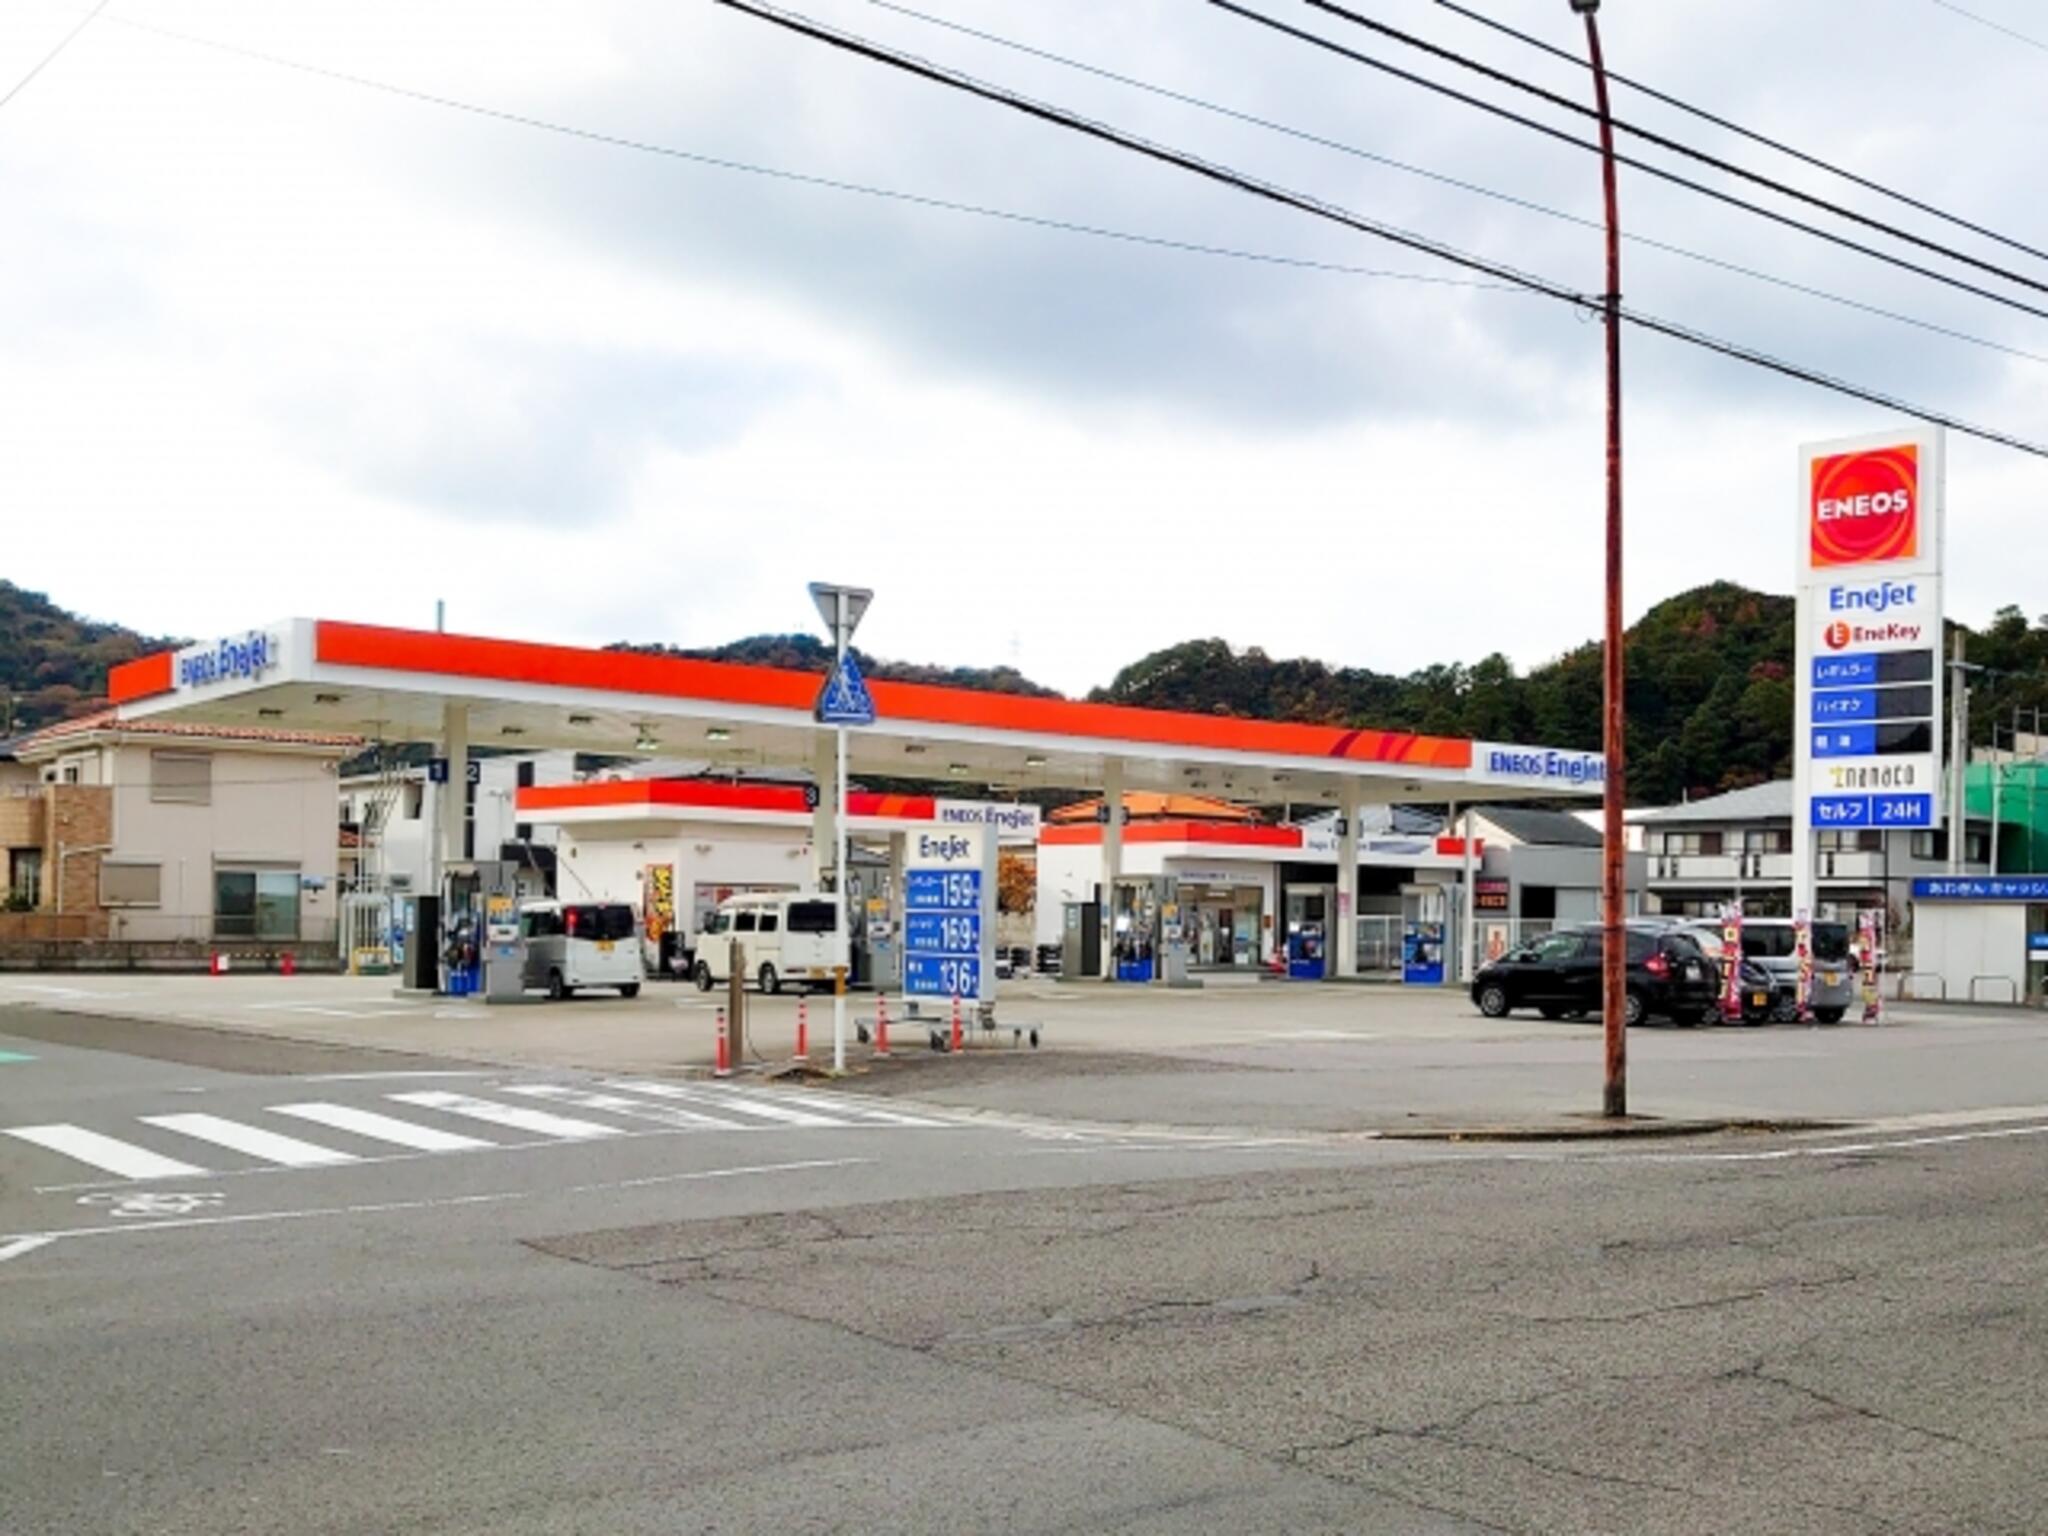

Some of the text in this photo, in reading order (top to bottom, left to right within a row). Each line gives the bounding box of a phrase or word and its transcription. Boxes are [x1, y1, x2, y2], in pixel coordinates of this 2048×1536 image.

[1817, 489, 1908, 521] ENEOS
[1853, 623, 1920, 642] EneKey
[1490, 752, 1542, 774] ENEOS
[1846, 765, 1915, 788] nanaco
[943, 809, 983, 822] ENEOS
[1819, 802, 1864, 820] セルフ
[1882, 801, 1922, 819] 24H
[942, 873, 971, 906] 159
[940, 959, 971, 995] 136
